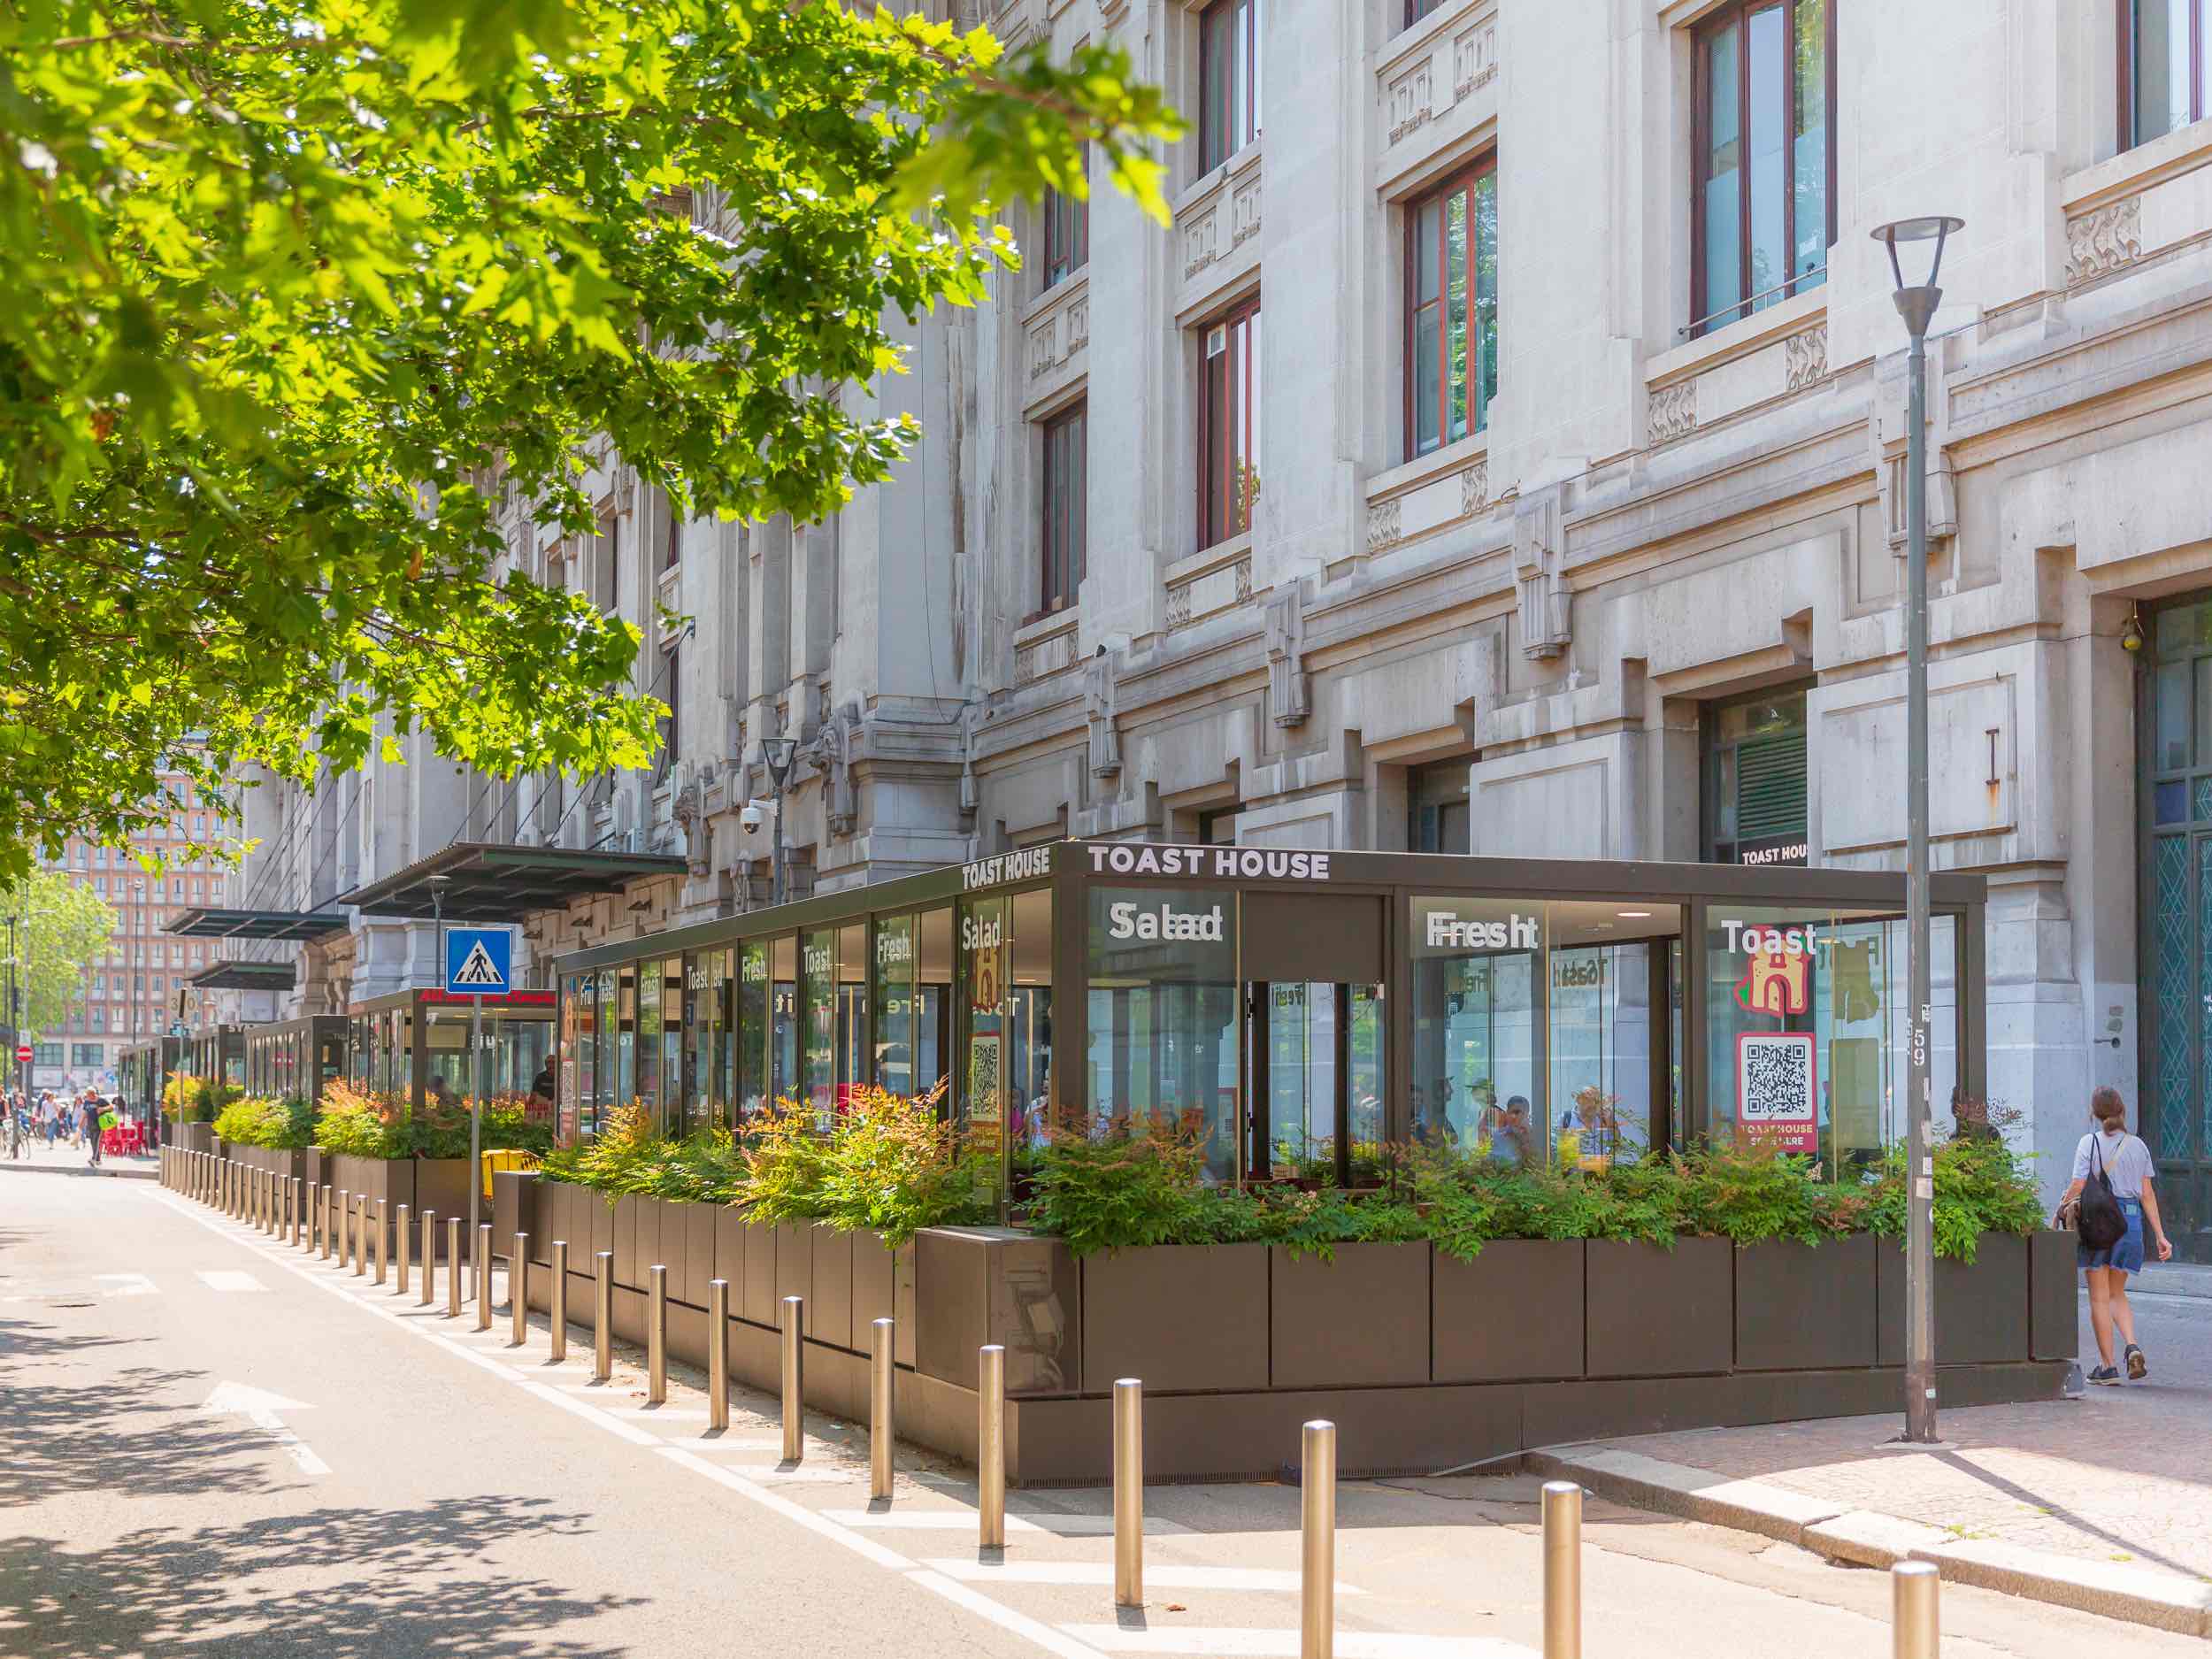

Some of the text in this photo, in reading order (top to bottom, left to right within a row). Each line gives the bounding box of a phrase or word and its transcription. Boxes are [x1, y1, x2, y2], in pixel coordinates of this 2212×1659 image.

[962, 847, 1050, 890] TOAST HOUSE
[1087, 846, 1329, 879] TOAST HOUSE
[1743, 843, 1807, 865] TOAST HOU
[962, 912, 1001, 950] Salad
[1109, 902, 1223, 941] Salad
[1720, 919, 1816, 955] Toast
[803, 943, 832, 974] Toast
[877, 929, 912, 964] Fresh
[687, 964, 709, 990] Toast
